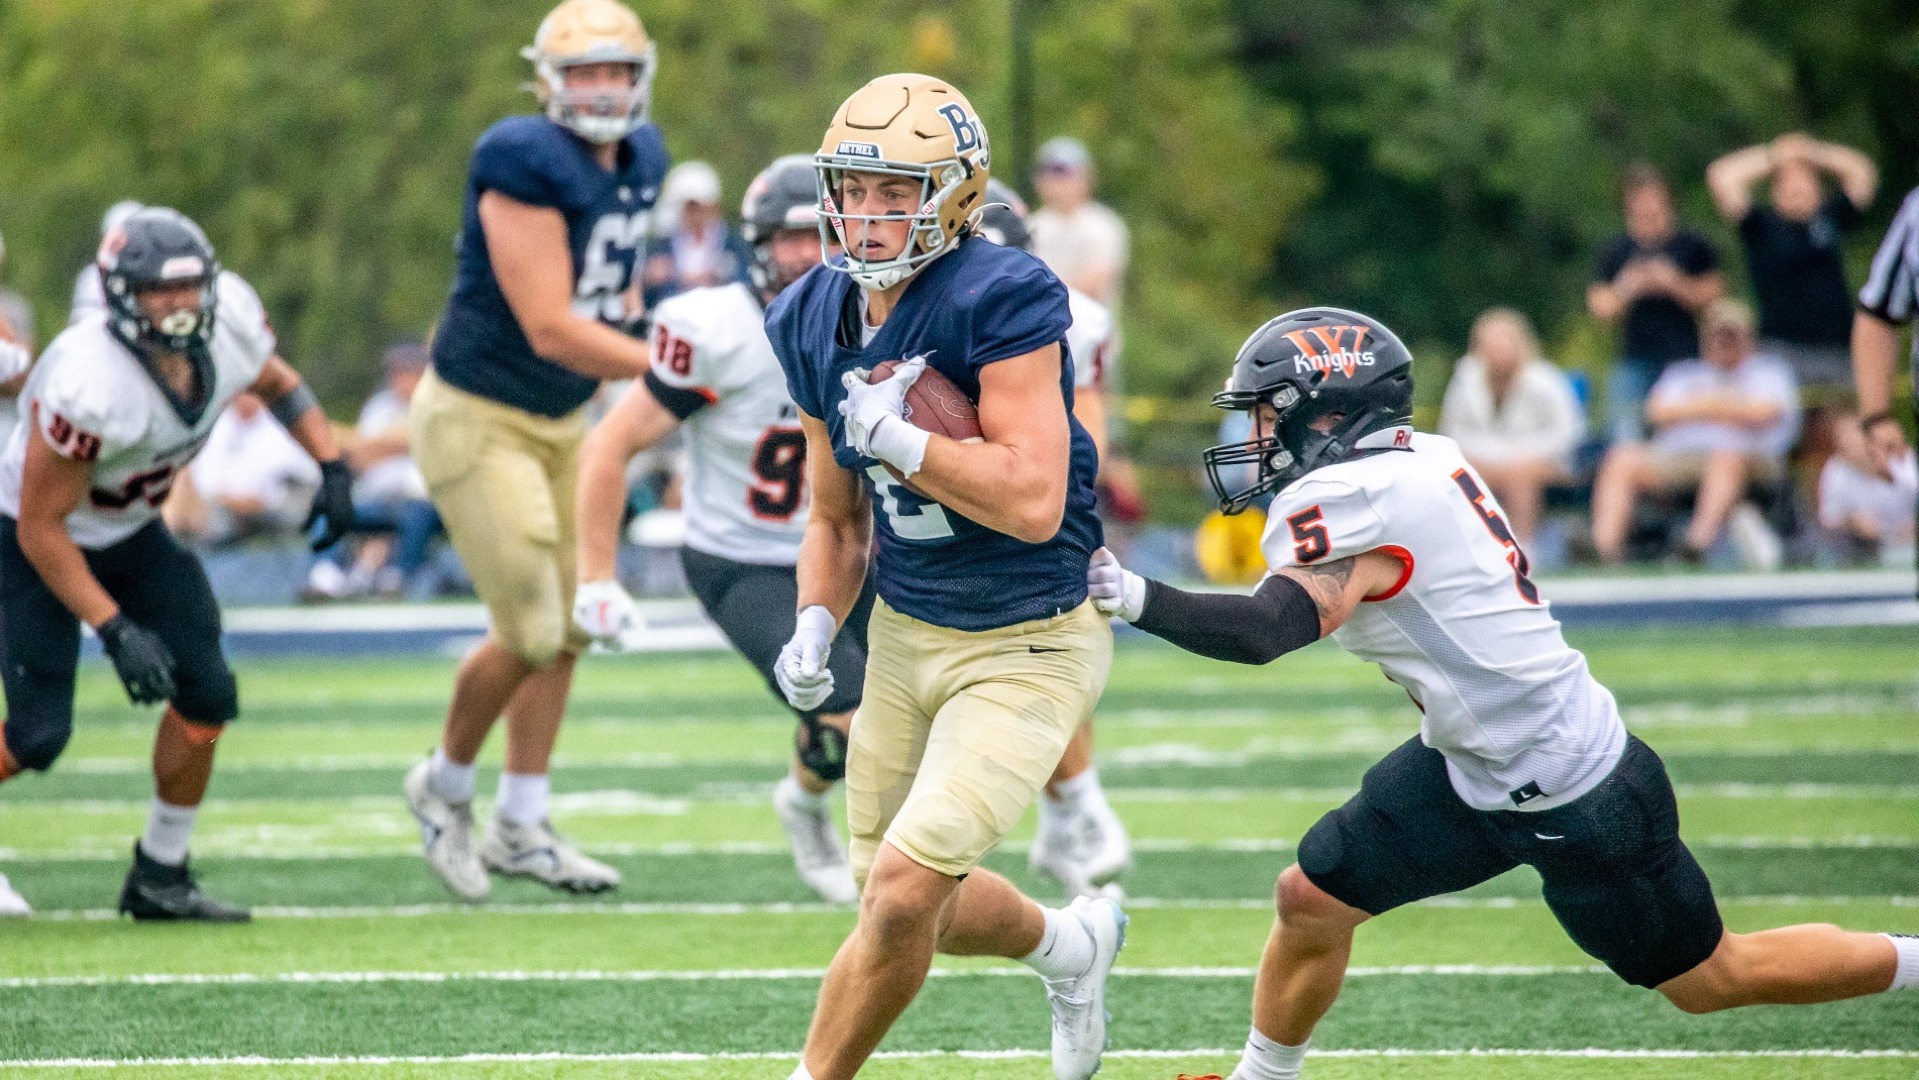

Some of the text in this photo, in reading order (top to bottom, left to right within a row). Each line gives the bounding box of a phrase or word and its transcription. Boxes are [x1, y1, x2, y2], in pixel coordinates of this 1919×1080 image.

[839, 142, 874, 156] BETHEL
[1293, 346, 1375, 374] Knights
[1286, 505, 1331, 565] 5
